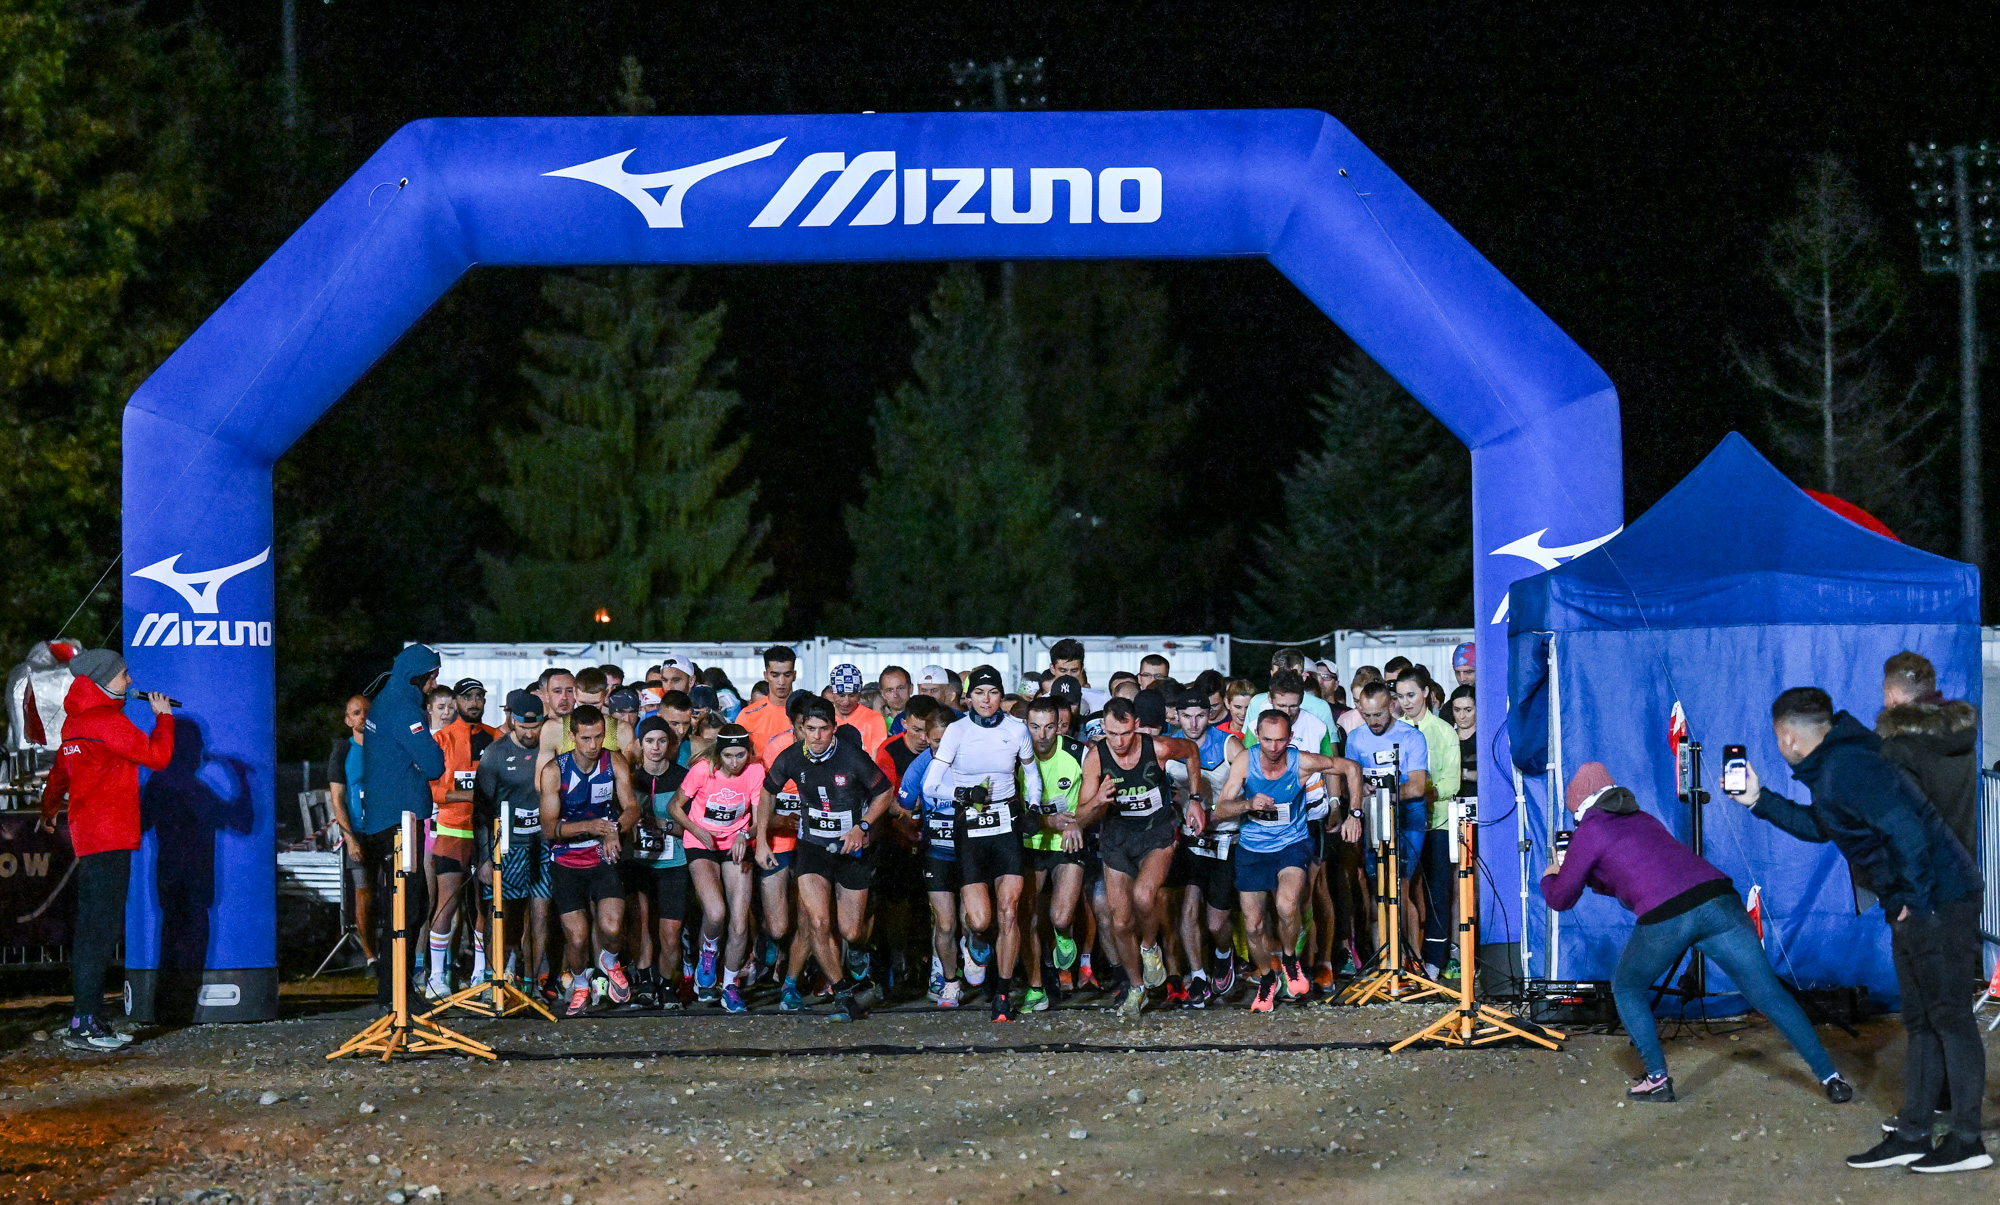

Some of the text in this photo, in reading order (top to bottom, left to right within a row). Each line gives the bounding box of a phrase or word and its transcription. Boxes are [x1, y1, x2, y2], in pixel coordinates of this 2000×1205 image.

[749, 151, 1162, 228] MIZUNO
[131, 612, 272, 647] MIZUNO
[1371, 778, 1384, 787] 91
[1130, 801, 1146, 810] 25
[715, 812, 731, 820] 26
[979, 816, 994, 825] 89
[820, 820, 835, 829] 86
